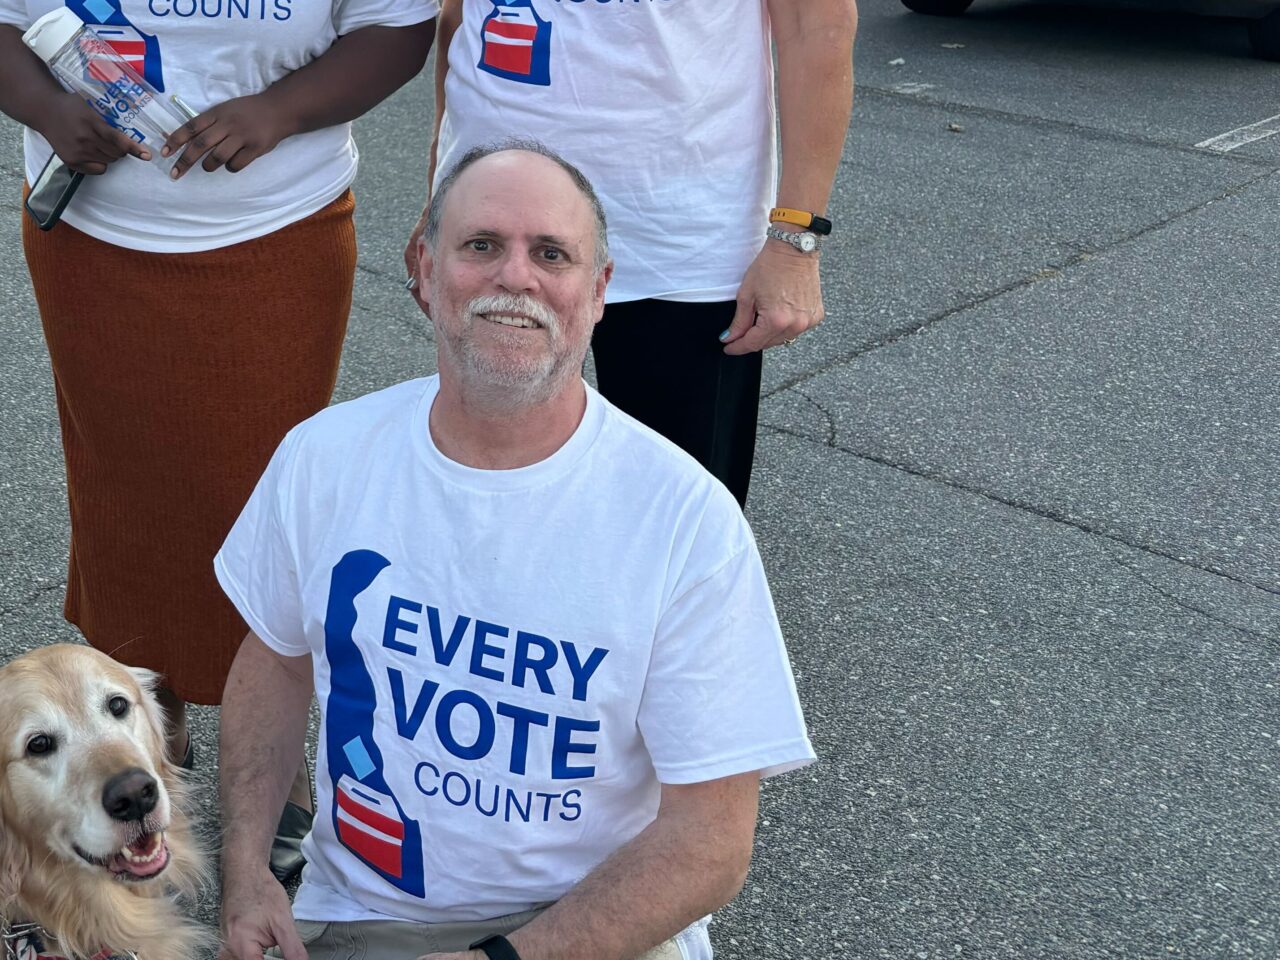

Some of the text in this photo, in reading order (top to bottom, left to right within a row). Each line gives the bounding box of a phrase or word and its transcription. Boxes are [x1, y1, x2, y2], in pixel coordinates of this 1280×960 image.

[96, 75, 130, 110] EVERY
[123, 94, 151, 124] COUNTS
[382, 595, 610, 702] EVERY
[386, 667, 600, 780] VOTE
[414, 761, 582, 823] COUNTS
